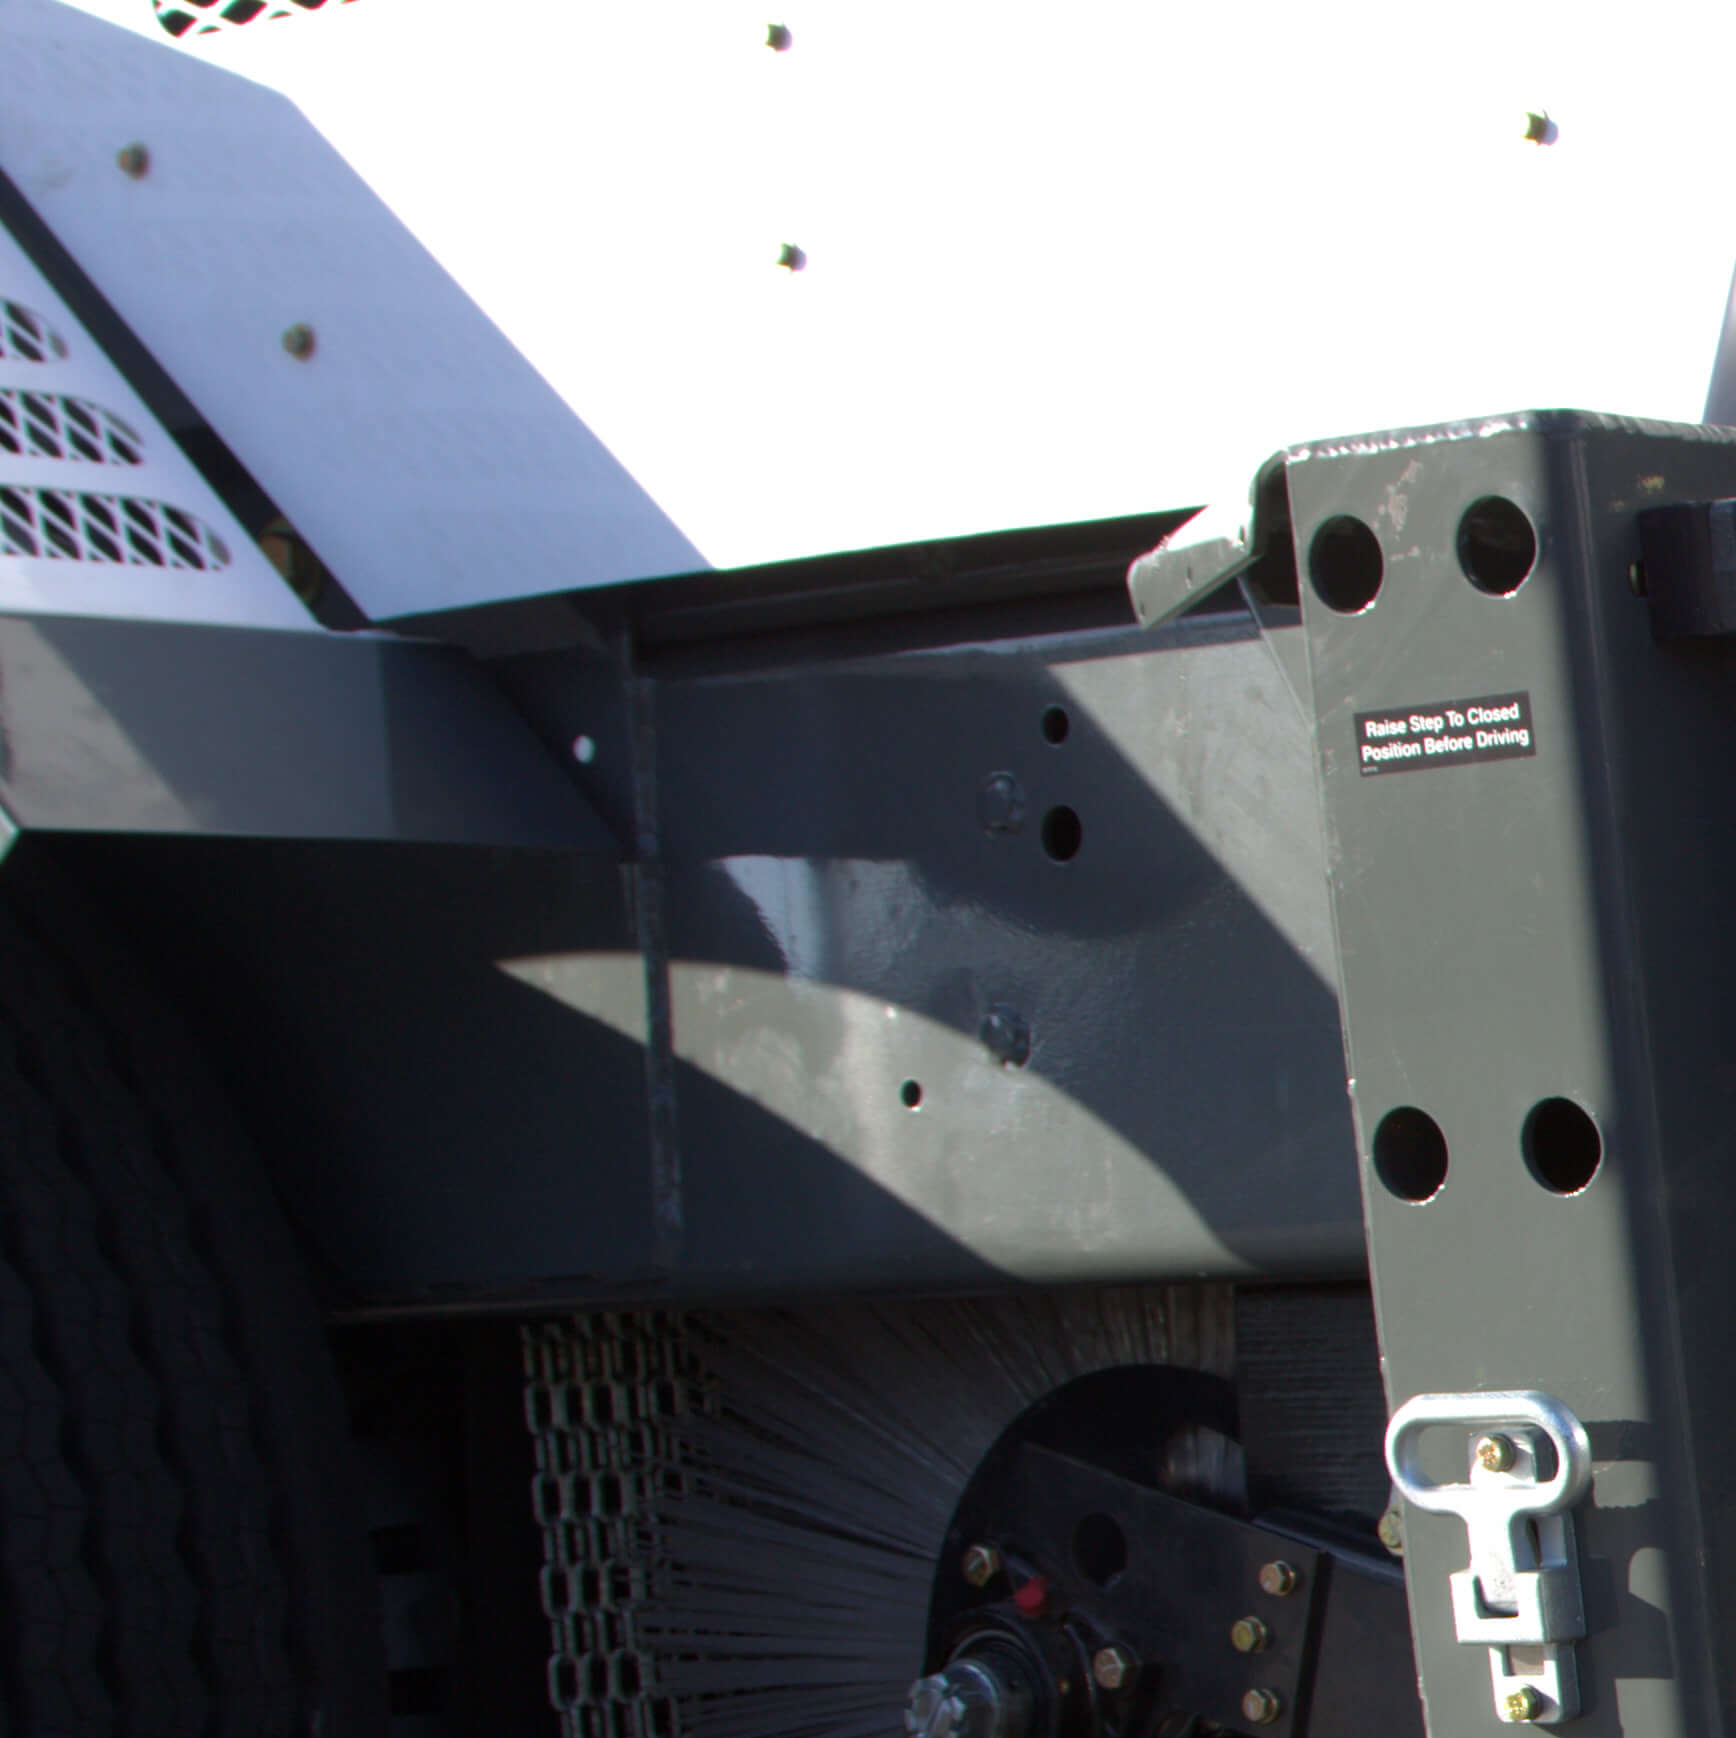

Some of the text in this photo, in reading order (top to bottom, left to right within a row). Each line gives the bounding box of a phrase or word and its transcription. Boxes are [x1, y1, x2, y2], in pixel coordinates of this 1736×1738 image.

[1365, 702, 1520, 738] Raise Step To Closed
[1361, 727, 1530, 763] Position Before Driving
